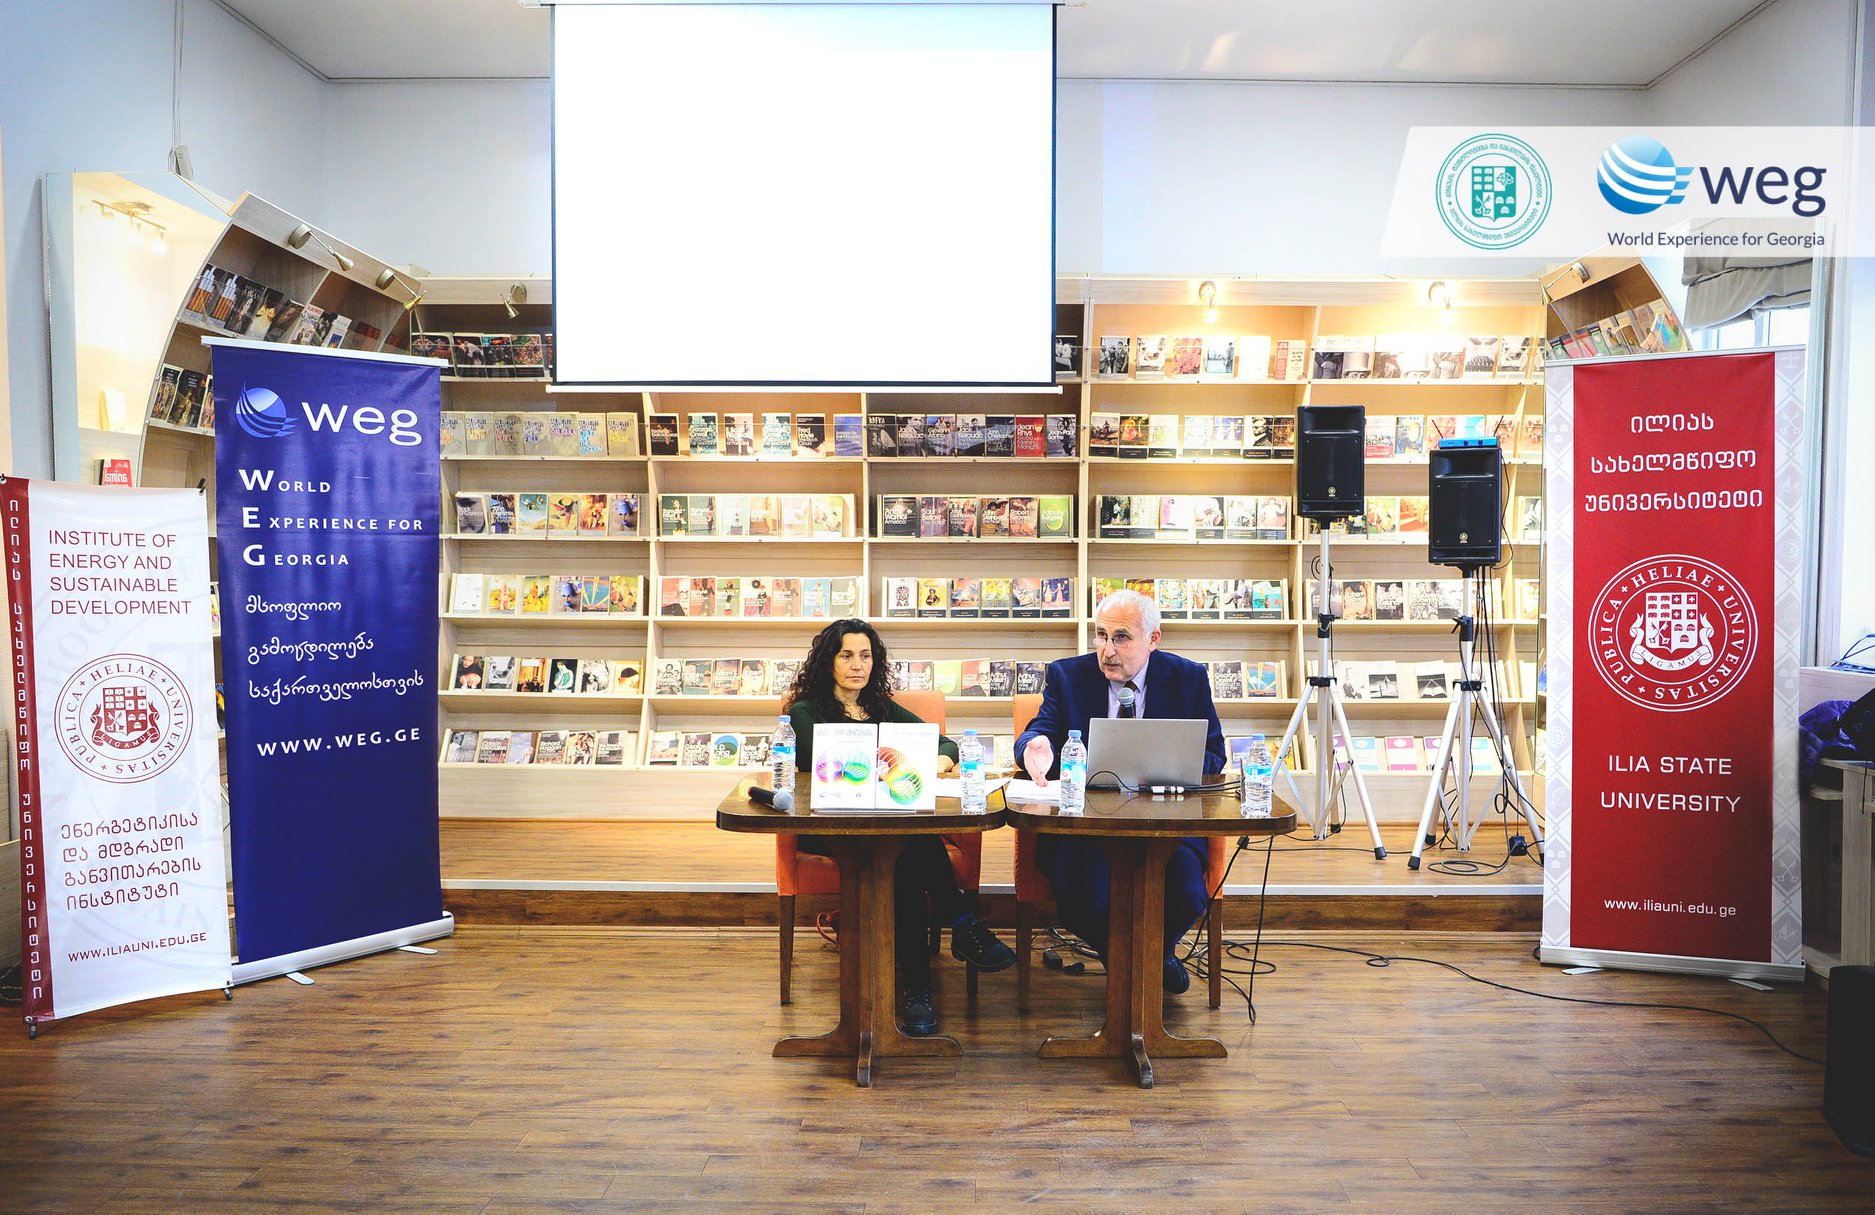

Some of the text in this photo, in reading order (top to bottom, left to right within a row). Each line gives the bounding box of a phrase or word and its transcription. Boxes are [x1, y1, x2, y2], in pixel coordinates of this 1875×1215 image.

[301, 402, 423, 446] weg
[1630, 412, 1714, 433] ილიას
[1591, 449, 1756, 473] სახელმწიფო
[1584, 489, 1763, 513] უნივერსიტეტი
[388, 519, 423, 530] FOR
[49, 529, 177, 548] INSTITUTE OF
[49, 553, 172, 570] ENERGY AND
[50, 577, 178, 592] SUSTAINABLE
[1631, 566, 1714, 589] HELIAE
[51, 600, 192, 615] DEVELOPMENT
[245, 595, 341, 620] მსოფლიო
[248, 632, 374, 665] გამოცდილება
[1600, 599, 1635, 685] PUBLICA
[1655, 595, 1745, 700] UNIVERSITAS
[90, 663, 158, 681] HELIAE
[249, 669, 424, 705] საქართველოსთვის
[65, 692, 96, 764] PUBLICA
[116, 687, 184, 774] UNIVERSITAS
[1608, 755, 1732, 775] ILIA STATE
[1601, 792, 1741, 812] UNIVERSITY
[61, 812, 199, 839] ენერგეტიკისა
[63, 836, 184, 862] და მდგრადი
[64, 857, 201, 886] განვითარების
[67, 882, 179, 911] ინსტიტუტი
[68, 932, 207, 962] WWW.ILIAUNI.EDU.GE
